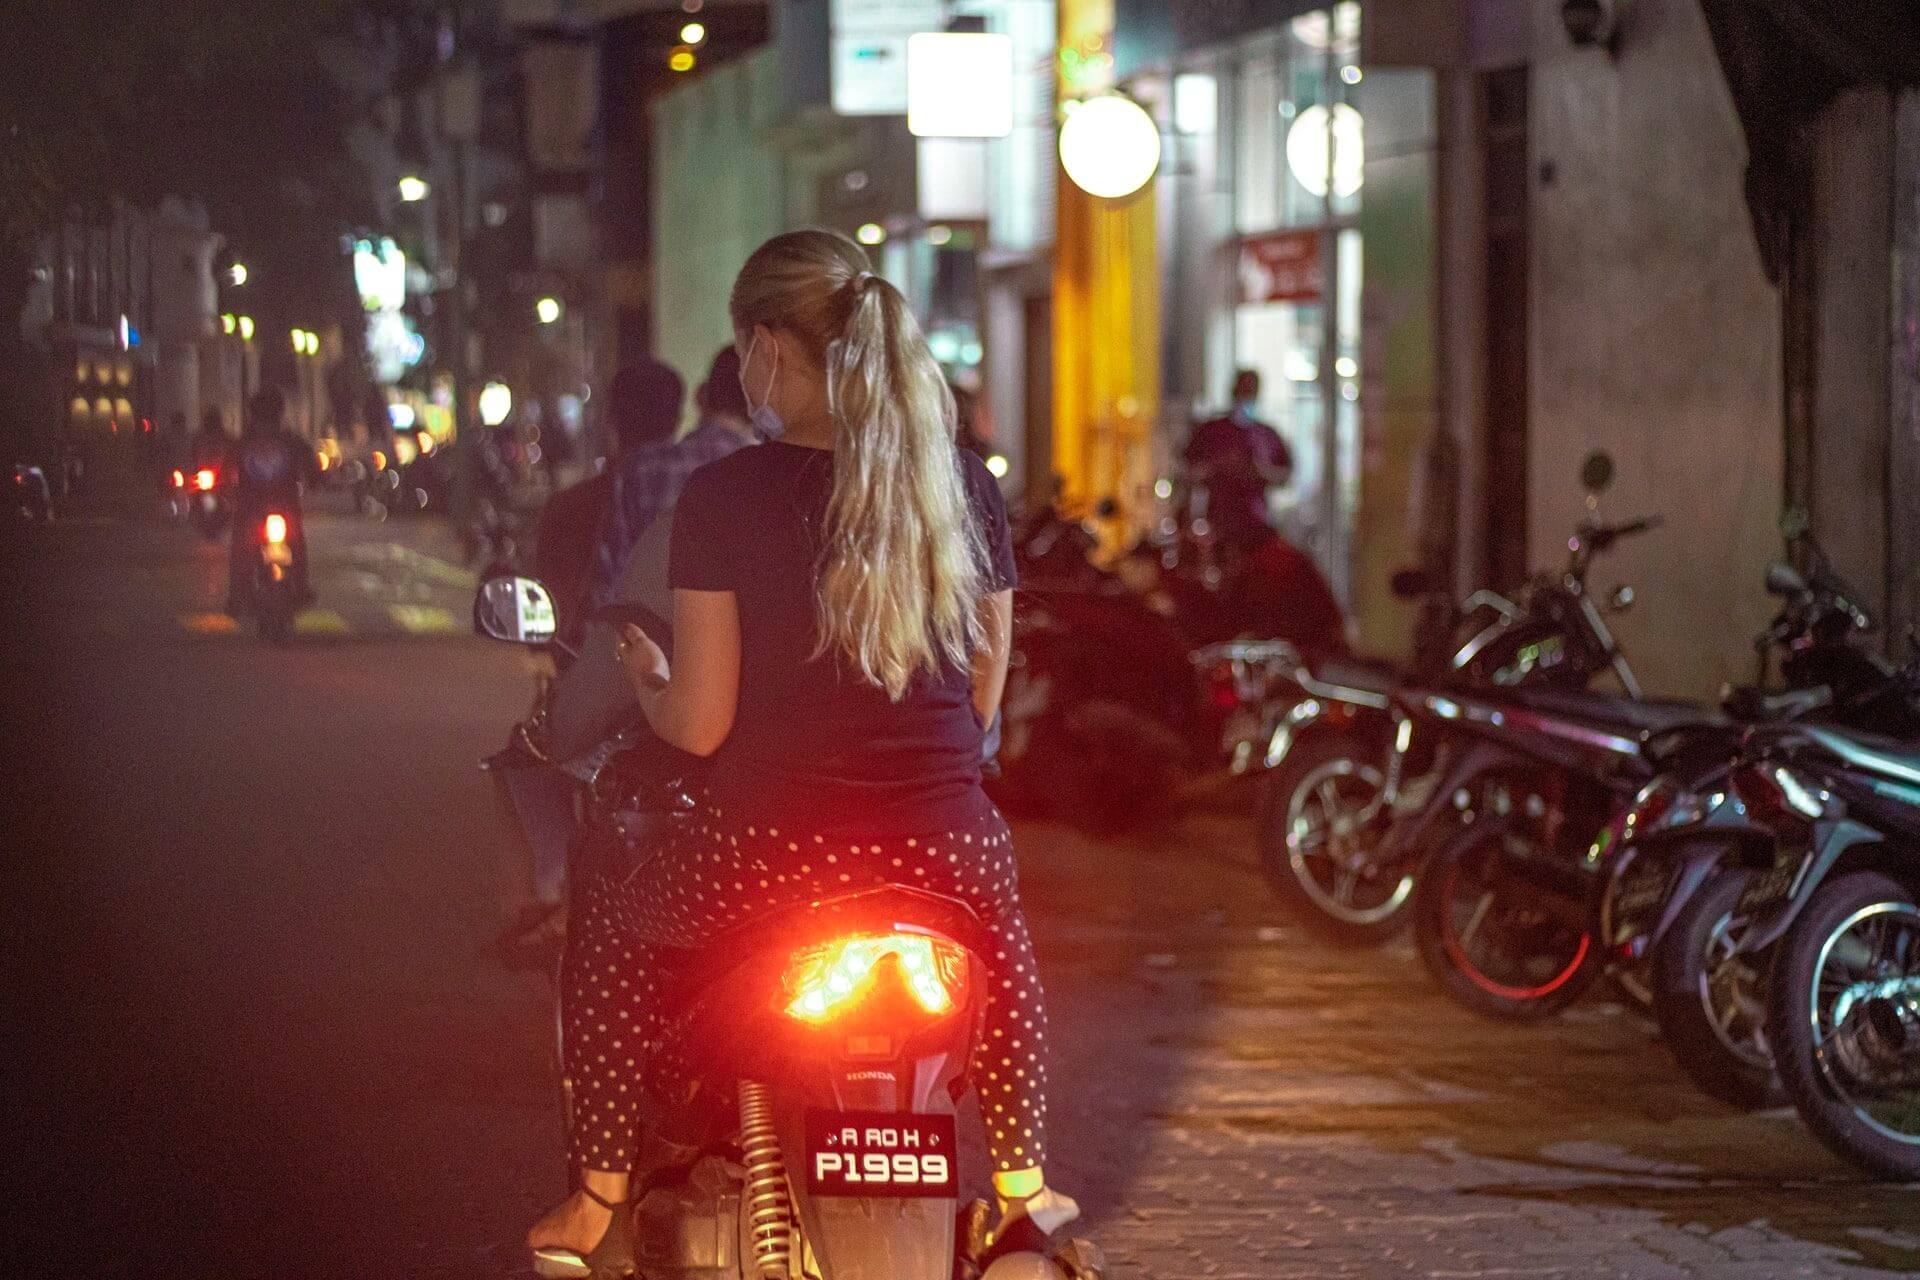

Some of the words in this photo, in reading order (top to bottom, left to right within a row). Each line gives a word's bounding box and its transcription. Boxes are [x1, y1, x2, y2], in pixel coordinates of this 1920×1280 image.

[846, 1071, 897, 1081] HONDA
[841, 1128, 858, 1146] A
[816, 1152, 949, 1184] P1999
